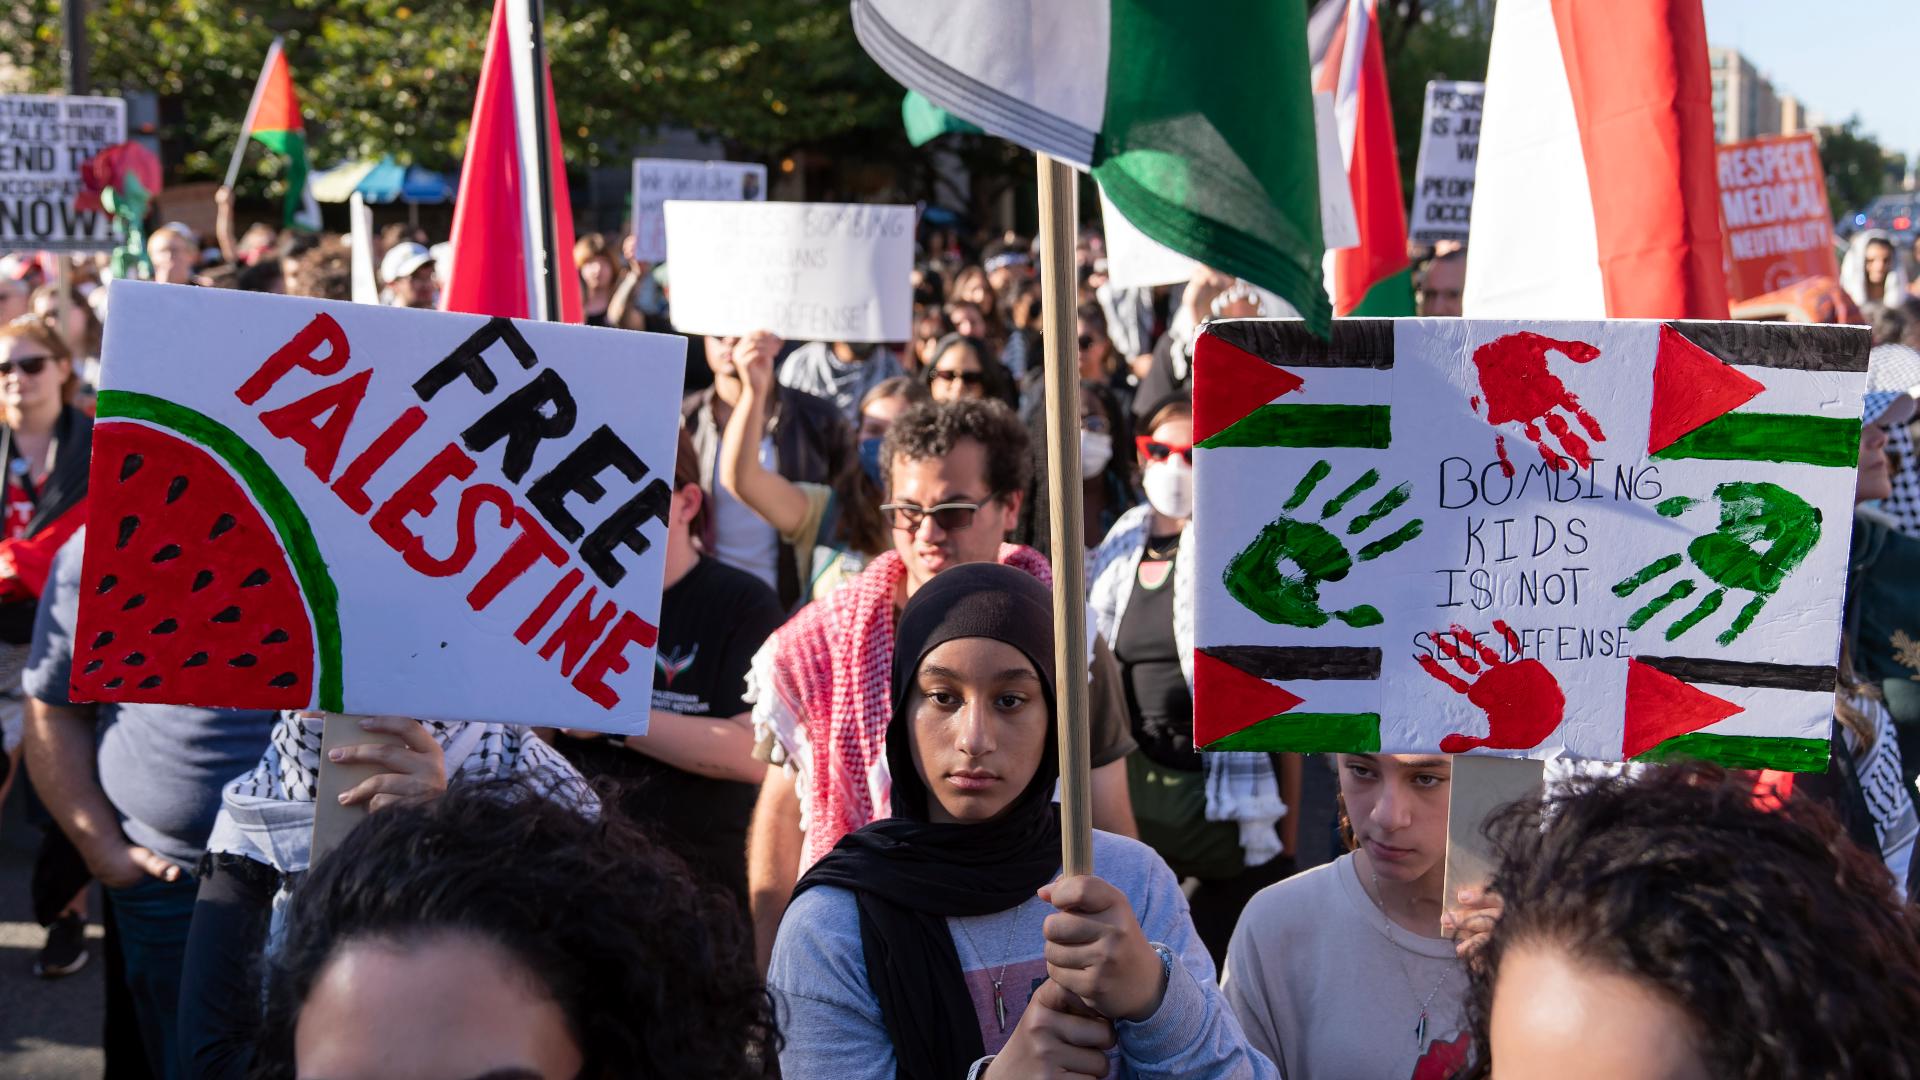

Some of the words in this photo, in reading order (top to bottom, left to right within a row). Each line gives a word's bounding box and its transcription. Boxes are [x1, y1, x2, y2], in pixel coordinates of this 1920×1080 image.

[1421, 176, 1475, 198] PEOP
[1717, 141, 1815, 189] RESPECT
[0, 199, 113, 237] NOW
[803, 206, 905, 239] BOMBING
[1721, 177, 1825, 229] MEDICAL
[1729, 219, 1830, 262] NEUTRALITY
[763, 271, 801, 294] NOT
[411, 316, 672, 589] FREE
[1439, 455, 1662, 509] BOMBING
[233, 311, 659, 711] PALESTINE
[1464, 514, 1589, 566] KIDS
[1434, 568, 1494, 611] IS
[1518, 567, 1590, 607] NOT
[1411, 631, 1491, 662] SELF
[1504, 625, 1632, 663] DEFENSE
